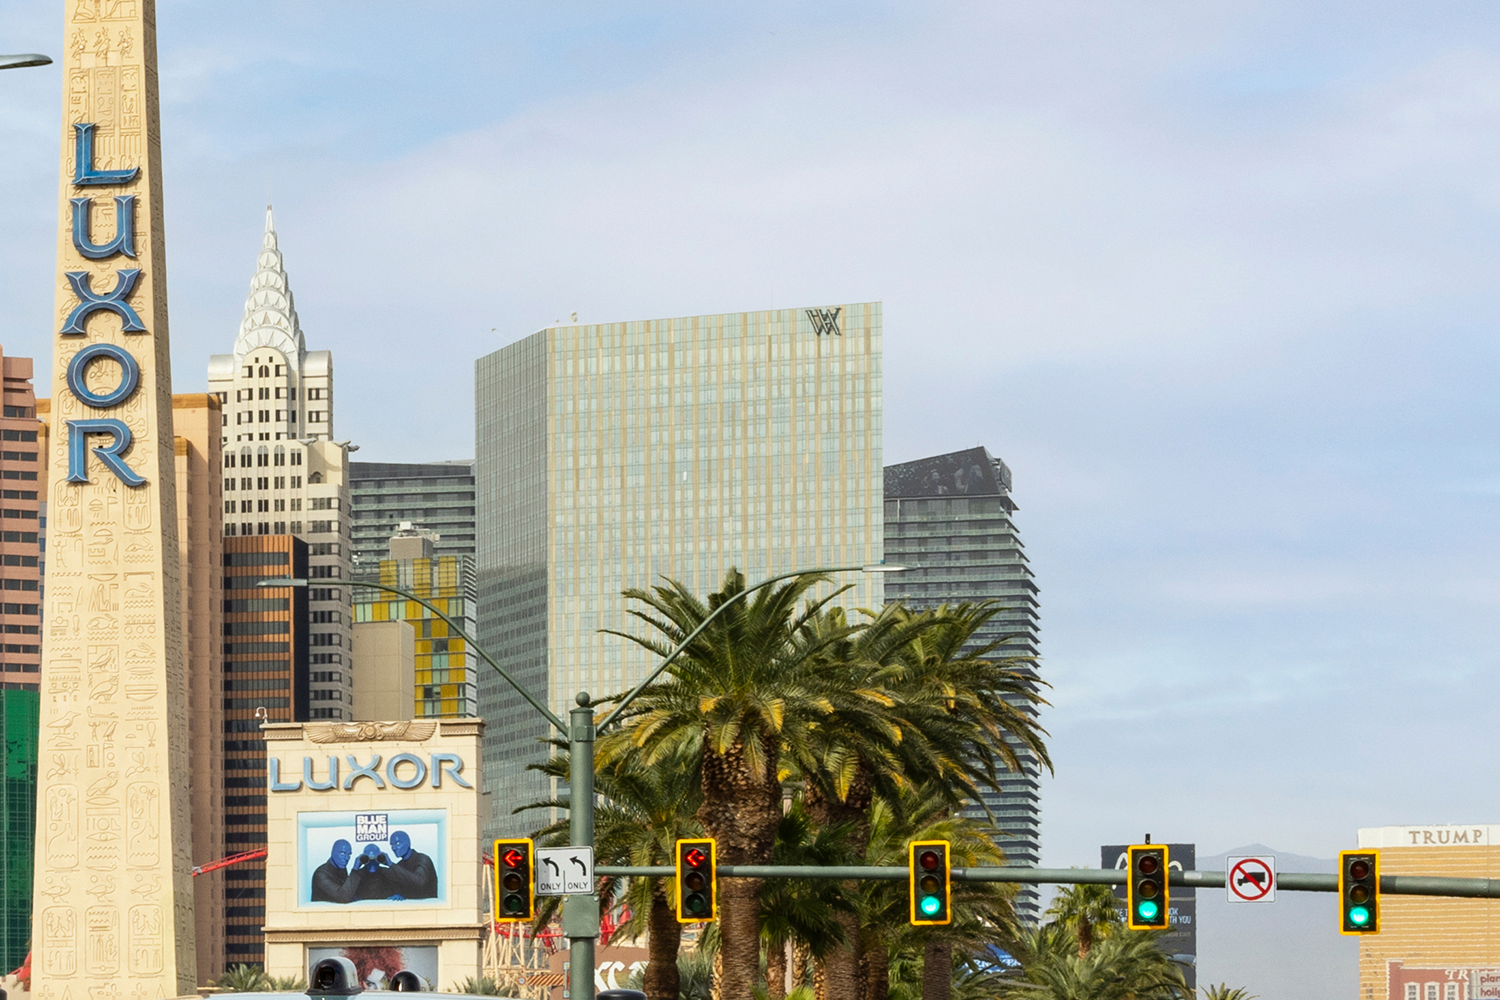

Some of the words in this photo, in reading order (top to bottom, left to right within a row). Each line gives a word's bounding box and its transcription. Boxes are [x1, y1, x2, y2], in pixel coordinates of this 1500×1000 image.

[59, 122, 148, 488] LUXOR
[269, 753, 473, 791] LUXOR
[356, 814, 387, 826] BLUE
[356, 824, 387, 835] MAN
[356, 834, 388, 842] GROUP
[1408, 829, 1483, 845] TRUMP
[540, 881, 562, 891] ONLY
[567, 881, 589, 890] ONLY
[1178, 916, 1192, 924] YOU
